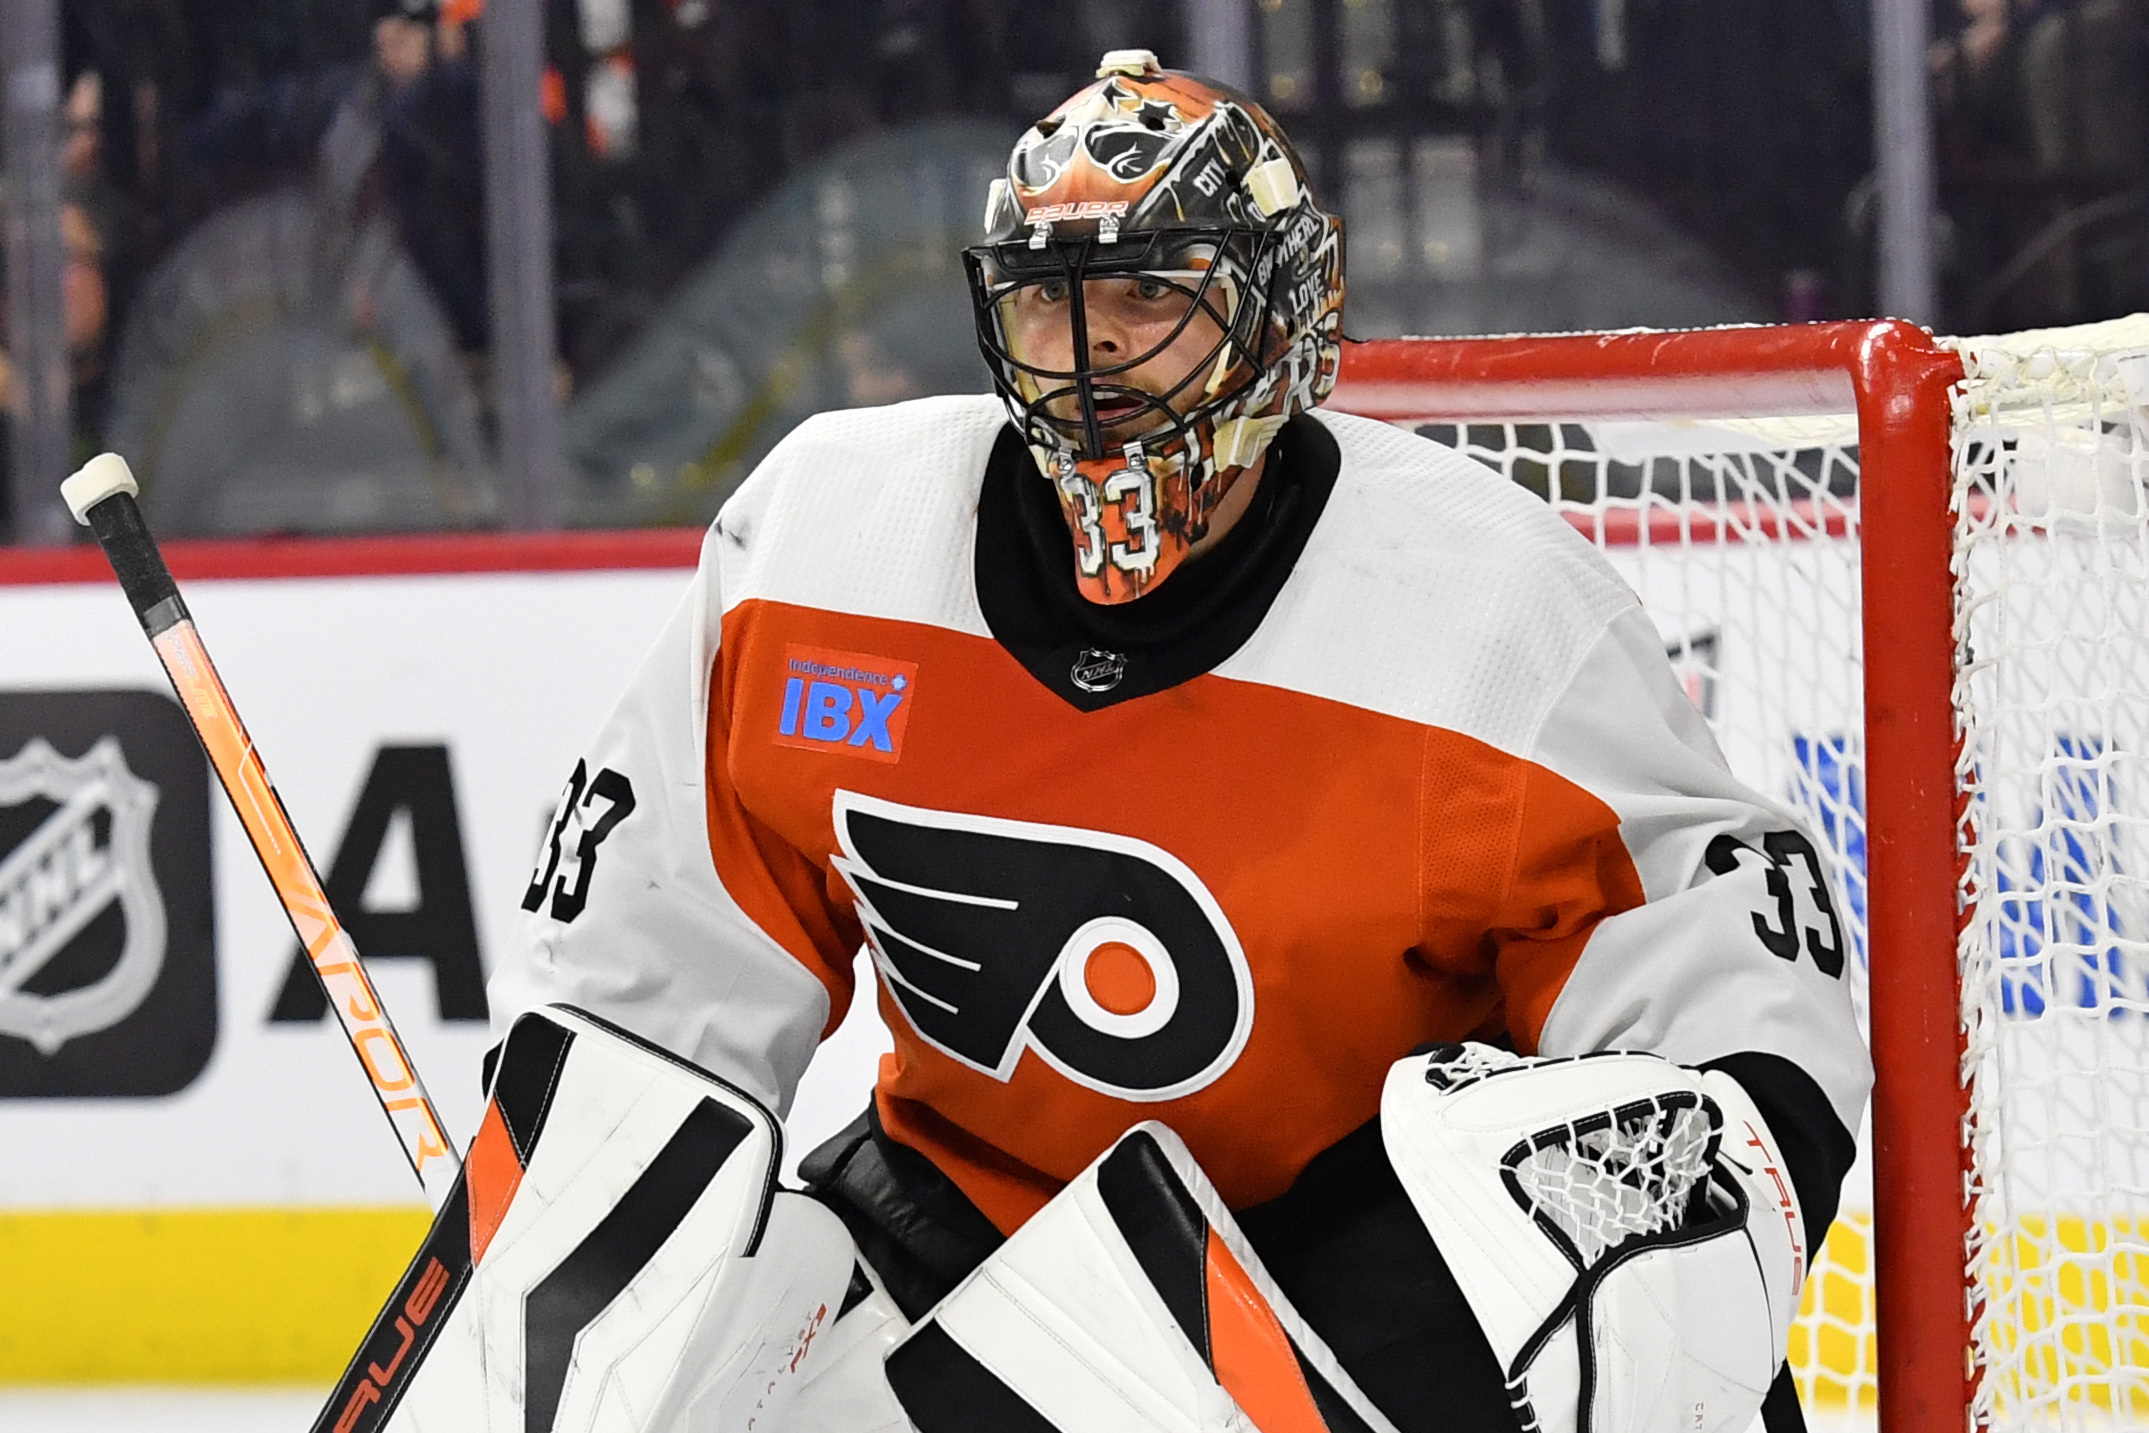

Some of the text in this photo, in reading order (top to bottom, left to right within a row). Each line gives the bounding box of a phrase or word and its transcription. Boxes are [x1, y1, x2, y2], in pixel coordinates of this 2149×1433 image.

[1024, 200, 1129, 226] BAUER
[1193, 157, 1226, 198] CITY
[1289, 267, 1324, 315] LOVE
[1059, 468, 1160, 576] 33
[779, 677, 903, 752] IBX
[789, 658, 887, 686] Independence
[264, 742, 492, 1026] A
[1705, 830, 1844, 980] 33
[1743, 1120, 1803, 1296] TRUE
[331, 1256, 451, 1433] RUE
